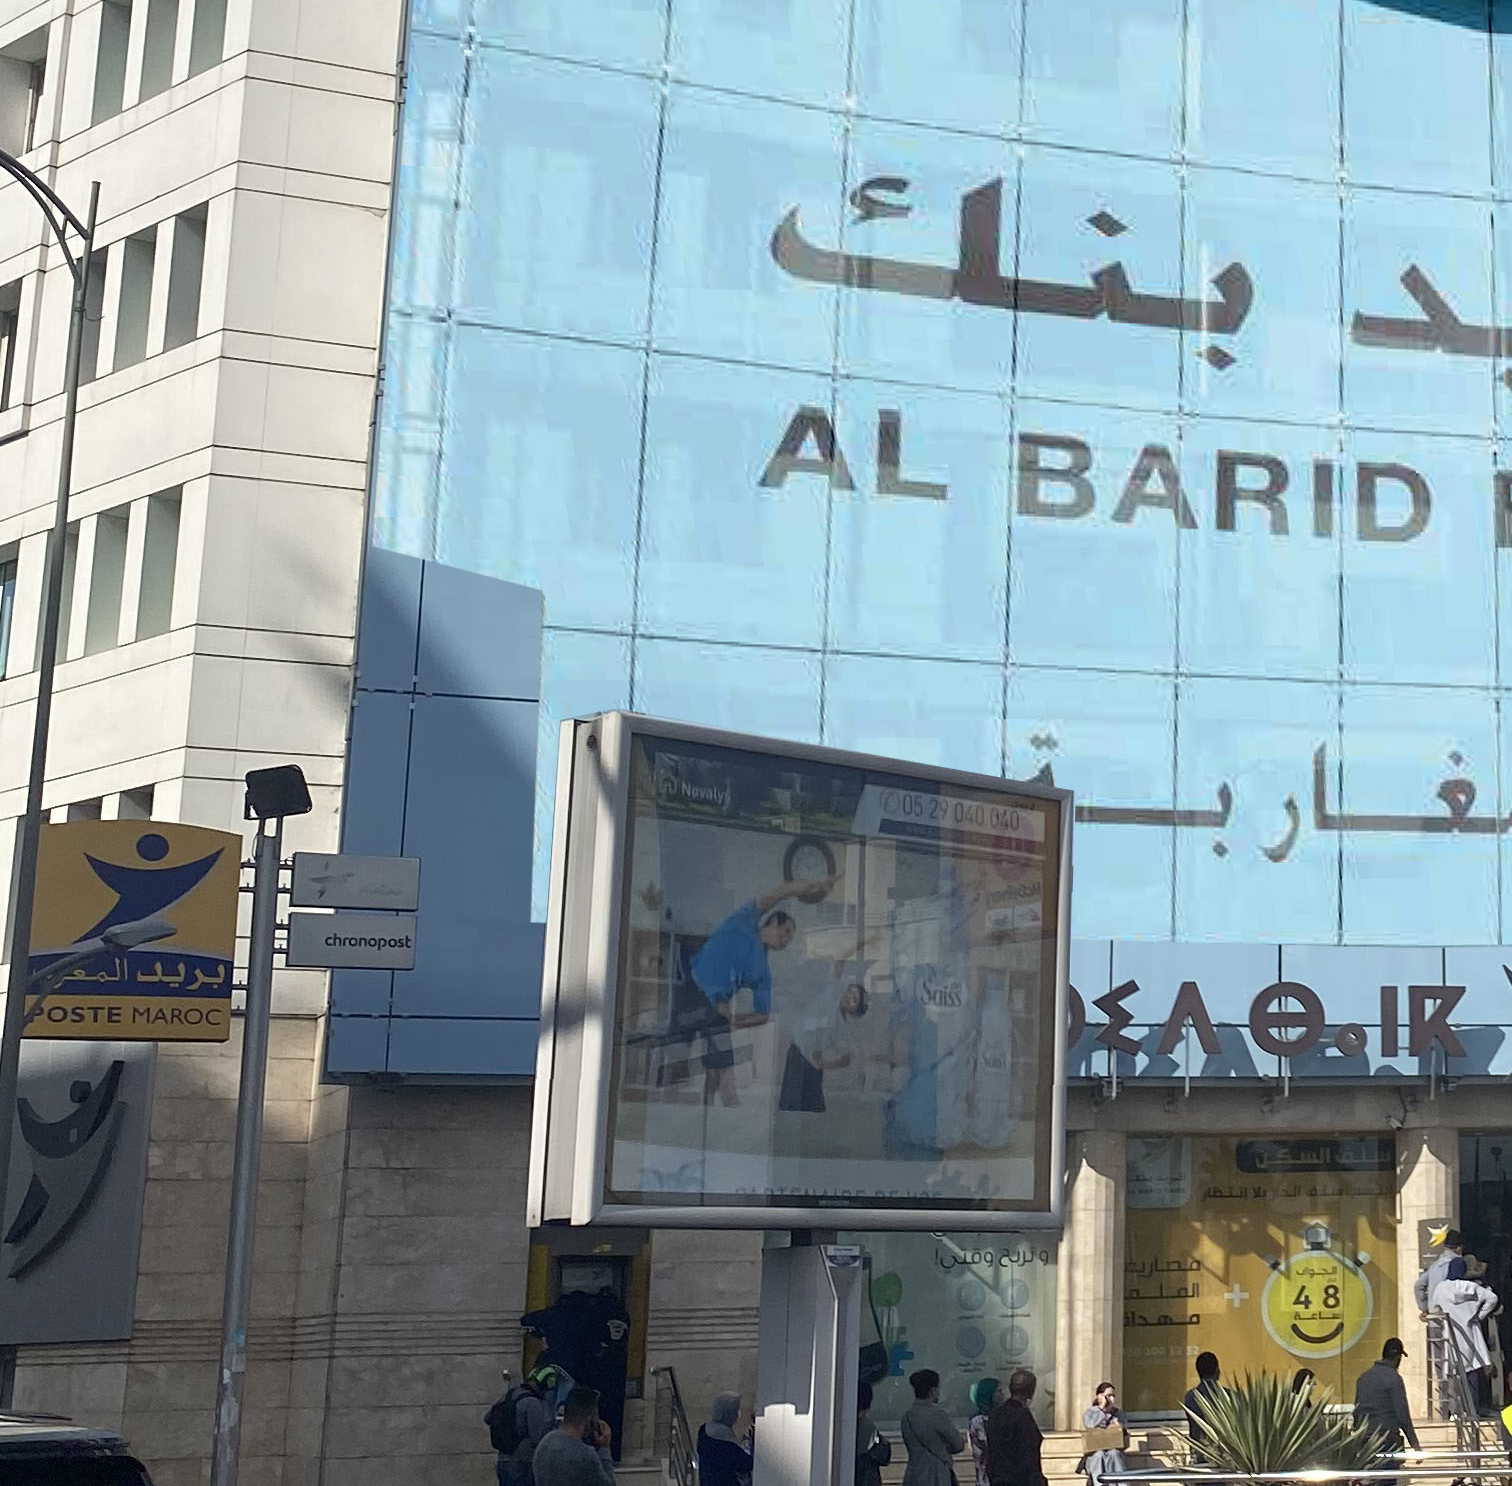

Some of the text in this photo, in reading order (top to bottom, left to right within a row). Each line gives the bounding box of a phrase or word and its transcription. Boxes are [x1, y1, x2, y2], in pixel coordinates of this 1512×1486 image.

[770, 176, 1254, 371] بنك
[757, 404, 950, 502] AL
[1016, 430, 1433, 544] BARID
[903, 794, 923, 817] 05
[954, 802, 985, 827] 040
[325, 933, 412, 950] chronopost
[32, 957, 226, 991] بريد المغر
[132, 1007, 222, 1026] MAROC
